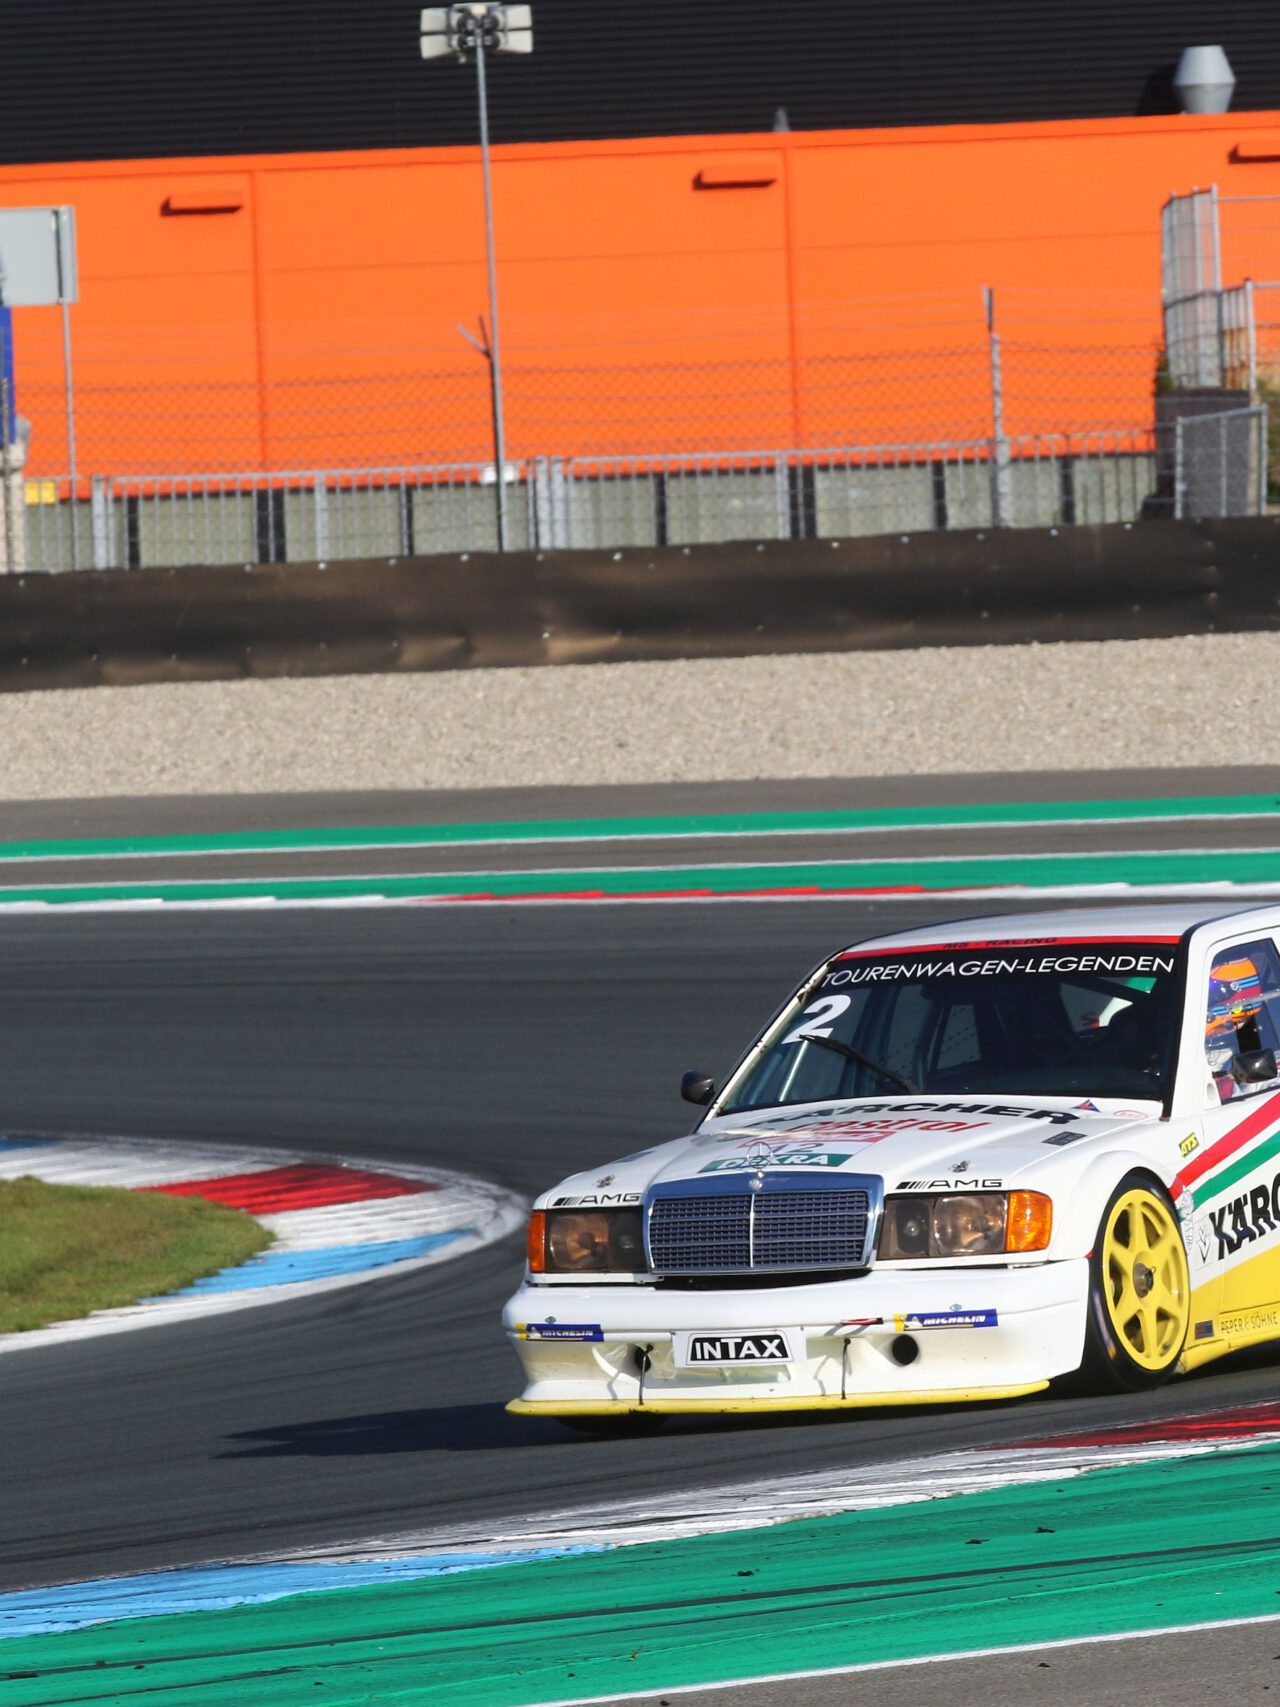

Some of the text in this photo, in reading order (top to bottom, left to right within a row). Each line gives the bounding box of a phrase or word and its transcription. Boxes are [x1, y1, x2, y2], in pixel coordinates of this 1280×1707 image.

[821, 955, 1175, 988] TOURENWAGEN-LEGENDEN
[781, 994, 851, 1045] 2
[927, 1178, 1003, 1190] AMG
[578, 1193, 642, 1206] AMG
[922, 1313, 987, 1327] MICHELIN
[695, 1337, 783, 1360] INTAX
